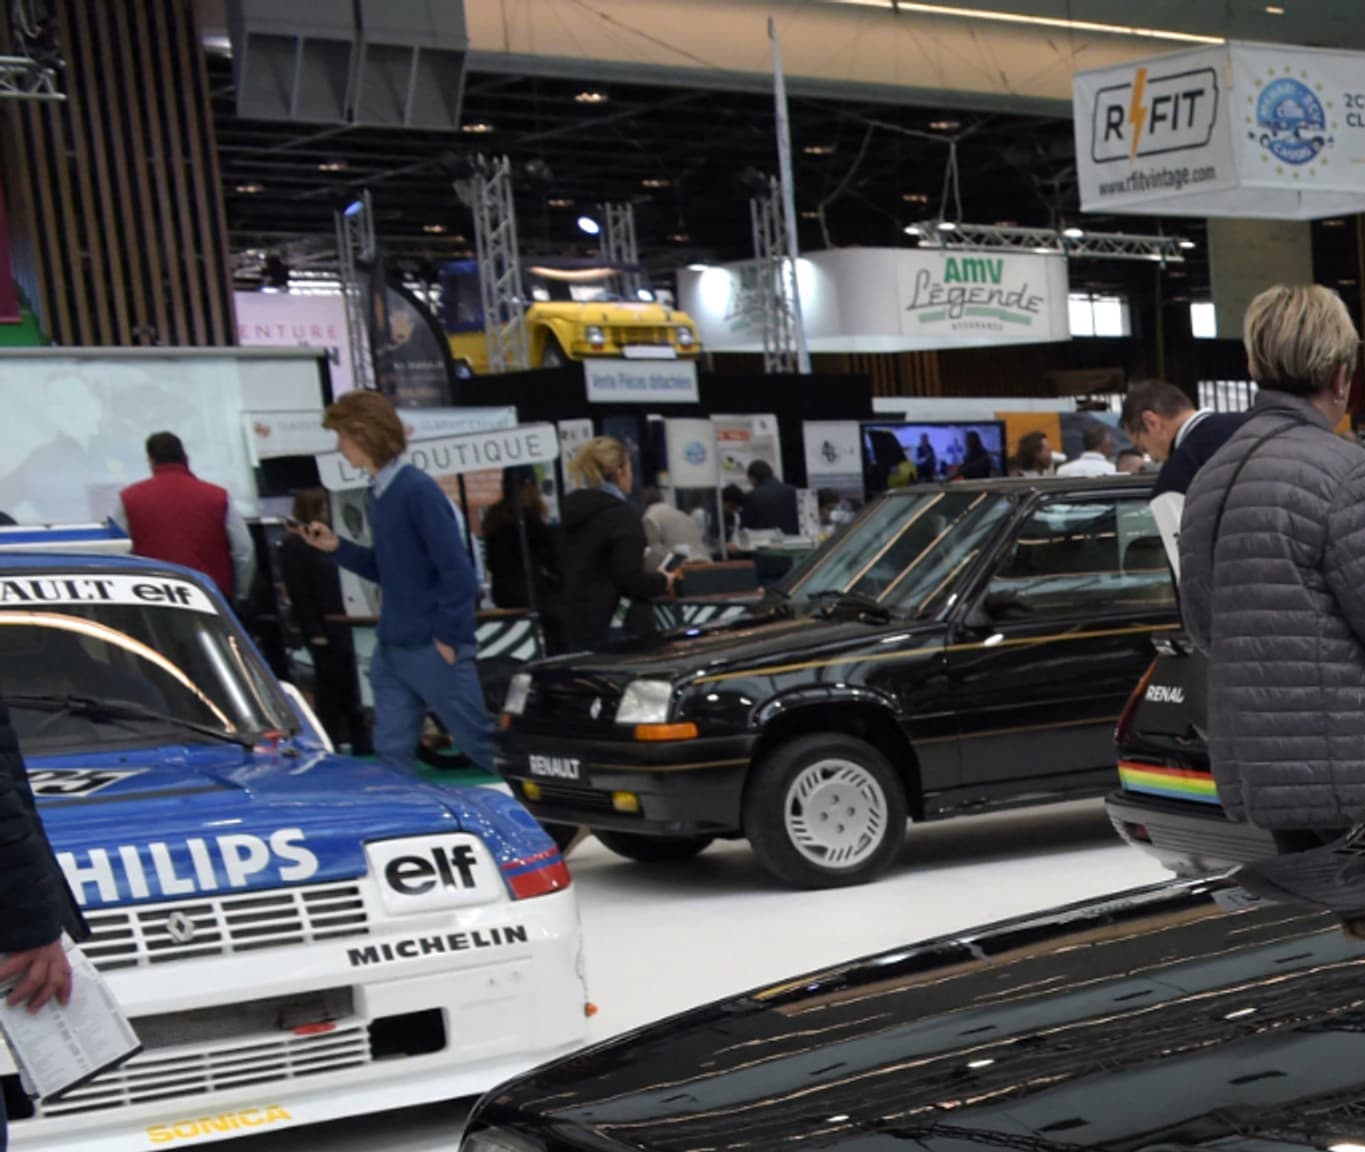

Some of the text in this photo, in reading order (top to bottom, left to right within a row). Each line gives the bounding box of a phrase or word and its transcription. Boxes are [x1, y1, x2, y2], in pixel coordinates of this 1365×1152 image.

[1098, 166, 1216, 196] www.rfitvintage.com
[131, 583, 192, 606] elf
[529, 755, 580, 780] RENAULT
[385, 845, 477, 896] elf
[349, 925, 528, 967] MICHELIN
[147, 1104, 292, 1144] SONICA
